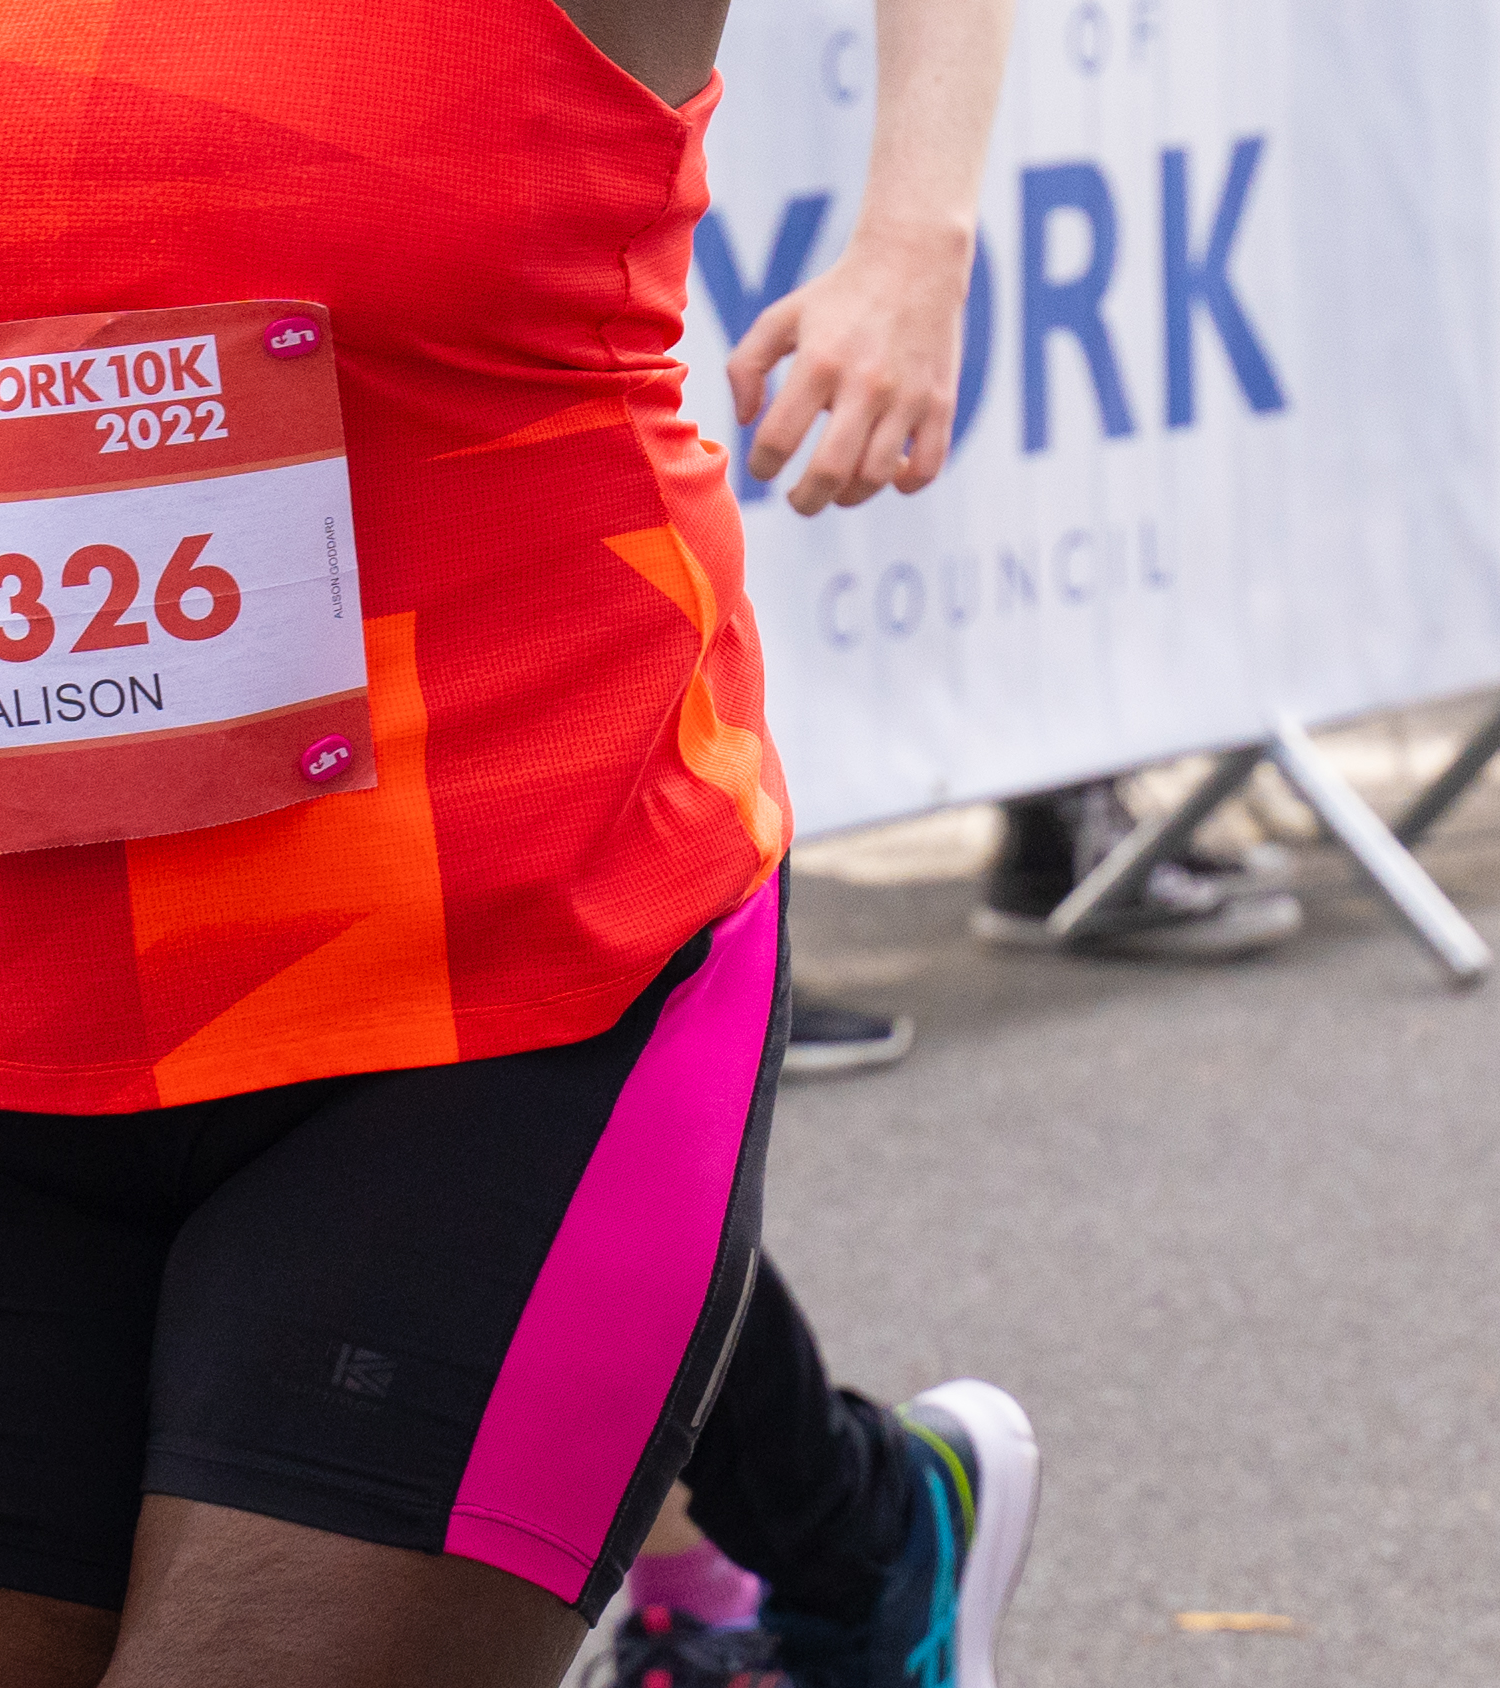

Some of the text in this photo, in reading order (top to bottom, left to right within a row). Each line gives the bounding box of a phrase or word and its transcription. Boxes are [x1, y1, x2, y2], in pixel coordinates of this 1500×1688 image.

[106, 346, 215, 397] 10K
[94, 401, 229, 454] 2022
[324, 516, 344, 620] ALISON GODDARD
[818, 516, 1175, 650] COUNCIL
